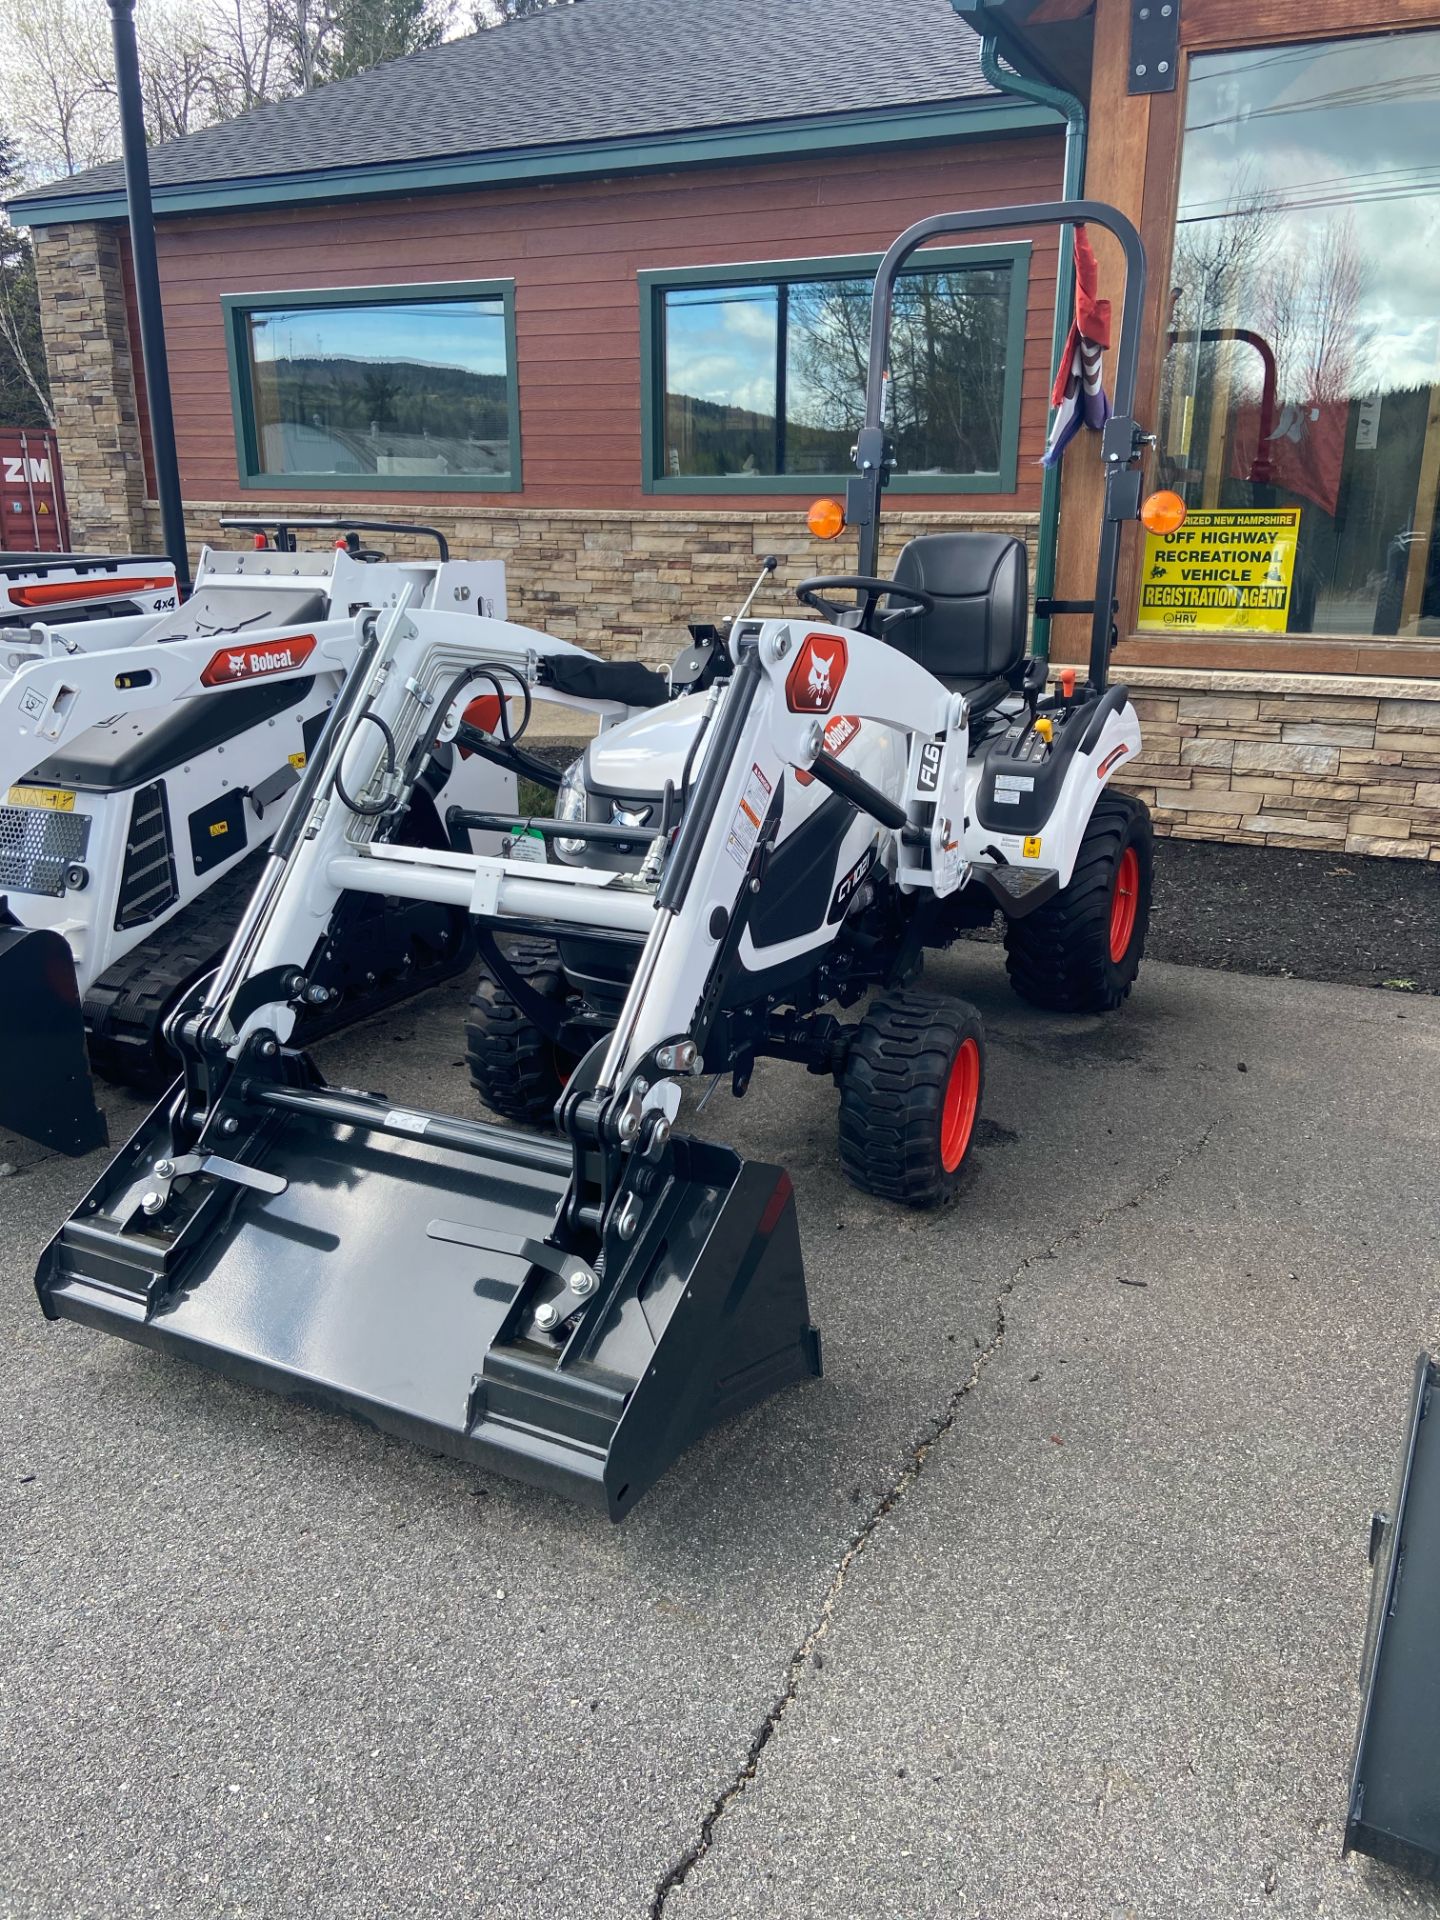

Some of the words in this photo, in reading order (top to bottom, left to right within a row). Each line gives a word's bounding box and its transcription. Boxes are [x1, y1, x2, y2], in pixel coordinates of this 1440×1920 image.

[3, 457, 51, 483] ZIM
[1214, 516, 1235, 525] NEW
[1237, 516, 1292, 525] HAMPSHIRE
[1164, 532, 1195, 544] OFF
[1201, 532, 1278, 544] HIGHWAY
[1155, 550, 1282, 562] RECREATIONAL
[1181, 569, 1251, 581] VEHICLE
[153, 597, 176, 611] 4x4
[1145, 586, 1237, 606] REGISTRATION
[1239, 588, 1286, 607] AGENT
[250, 649, 293, 673] Bobcat
[824, 715, 855, 751] Bobcat
[920, 744, 940, 788] FL6
